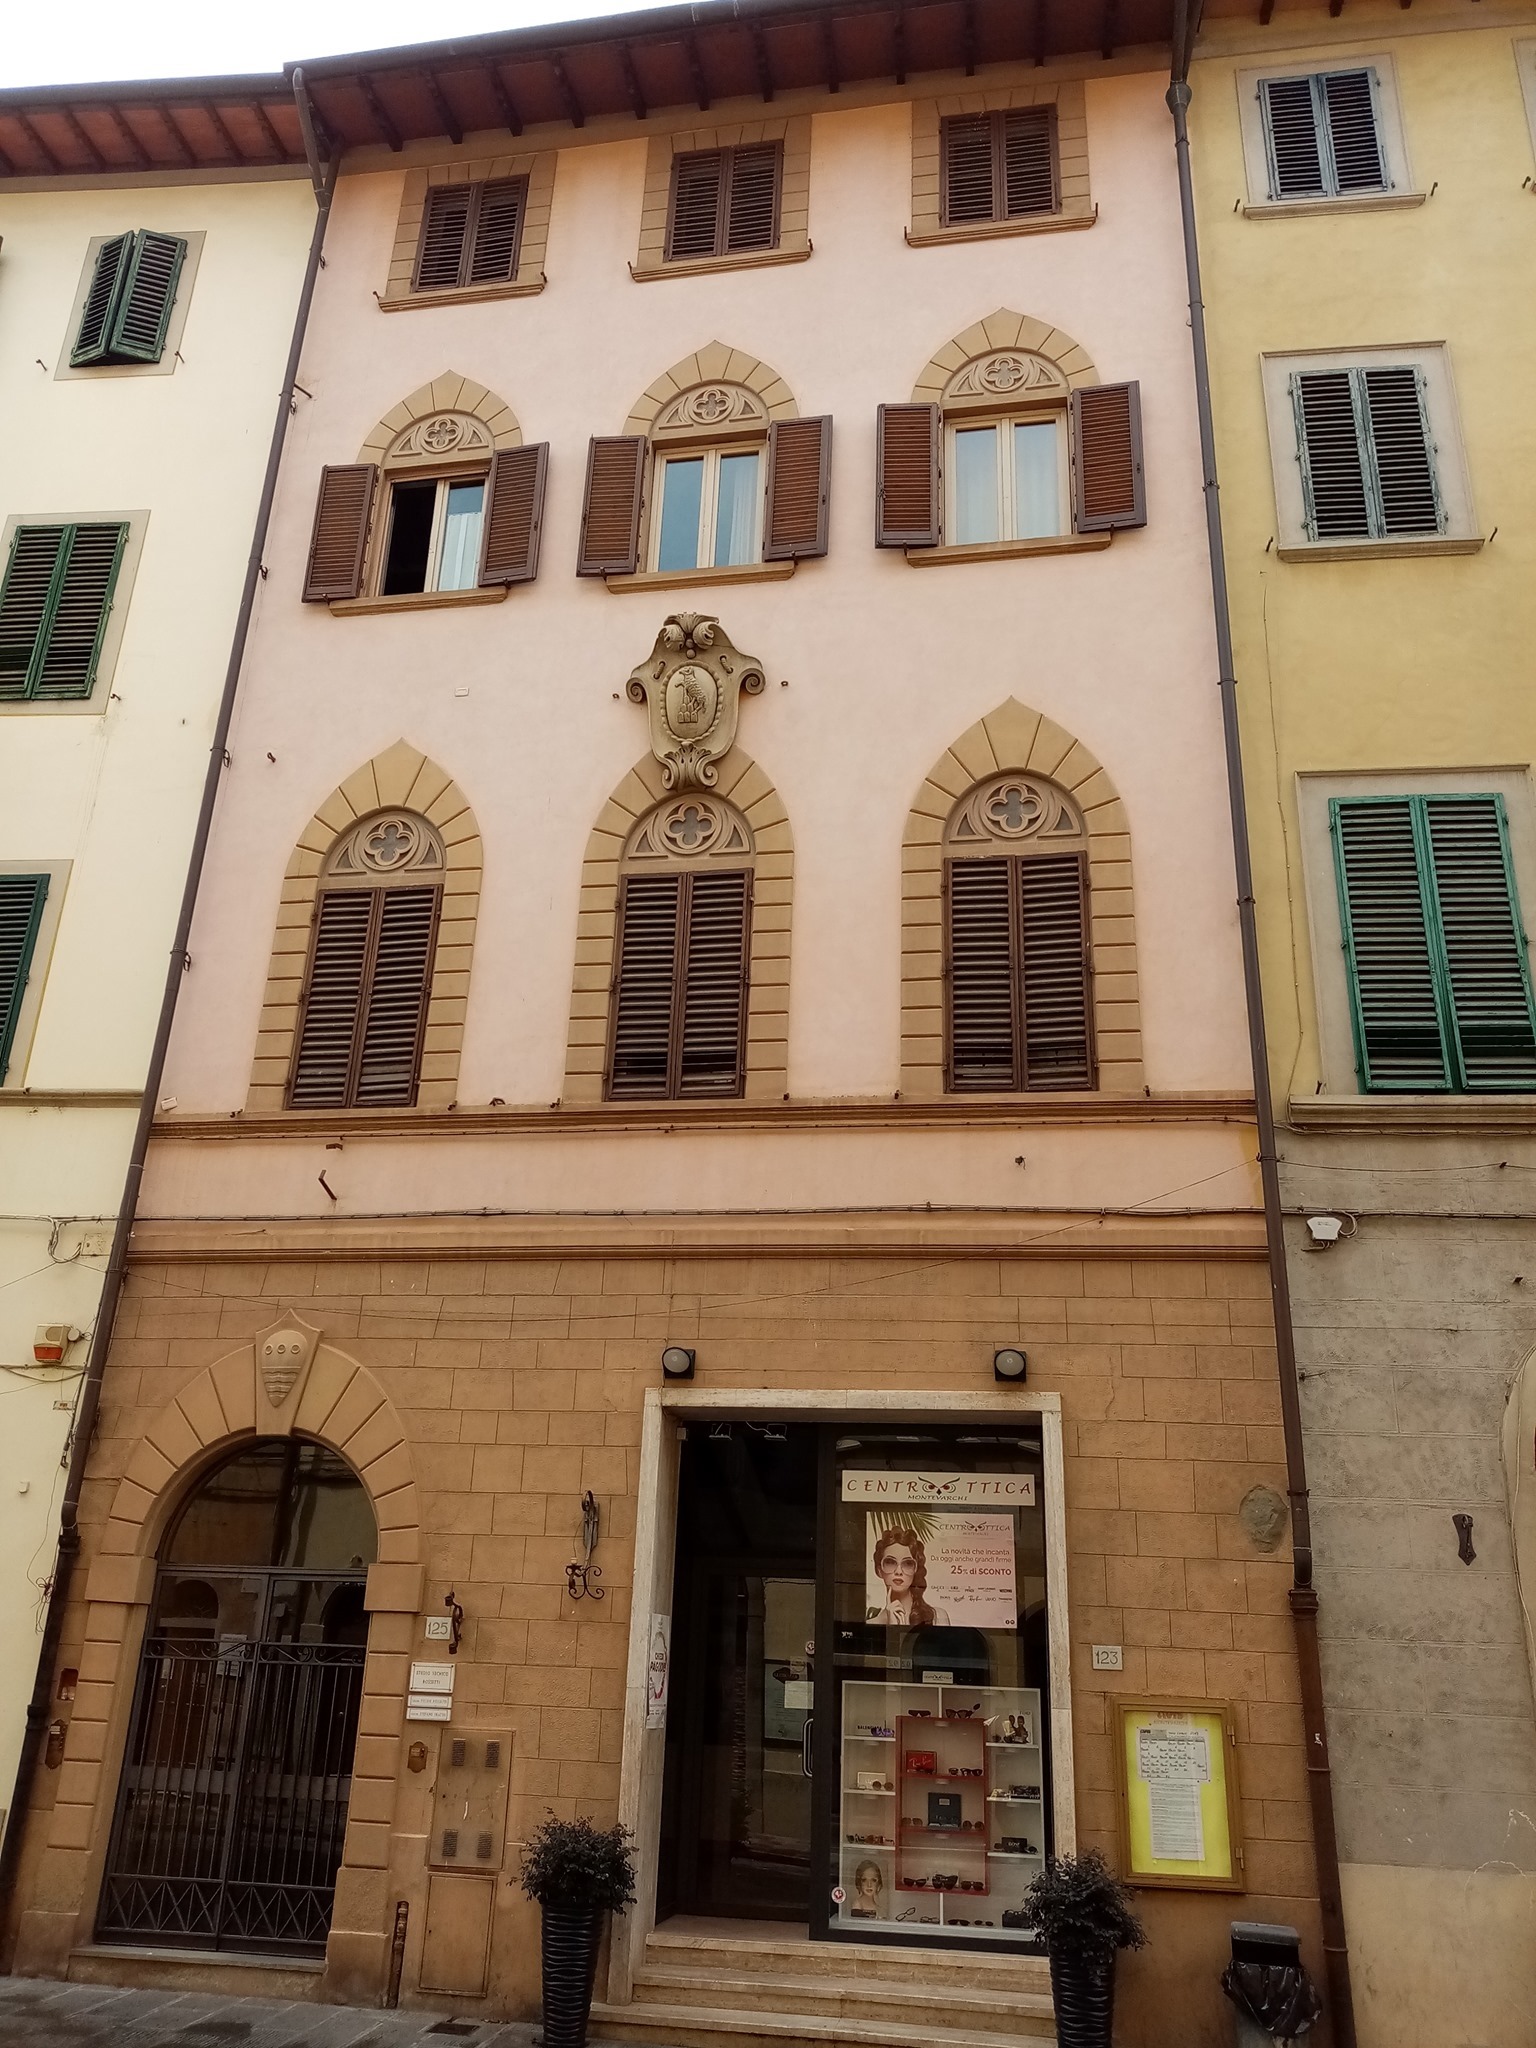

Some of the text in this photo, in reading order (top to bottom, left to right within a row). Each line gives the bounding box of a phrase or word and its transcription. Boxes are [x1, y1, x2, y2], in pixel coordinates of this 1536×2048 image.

[978, 1568, 1012, 1576] SCONTO
[427, 1621, 449, 1635] 125
[1095, 1650, 1119, 1665] 123
